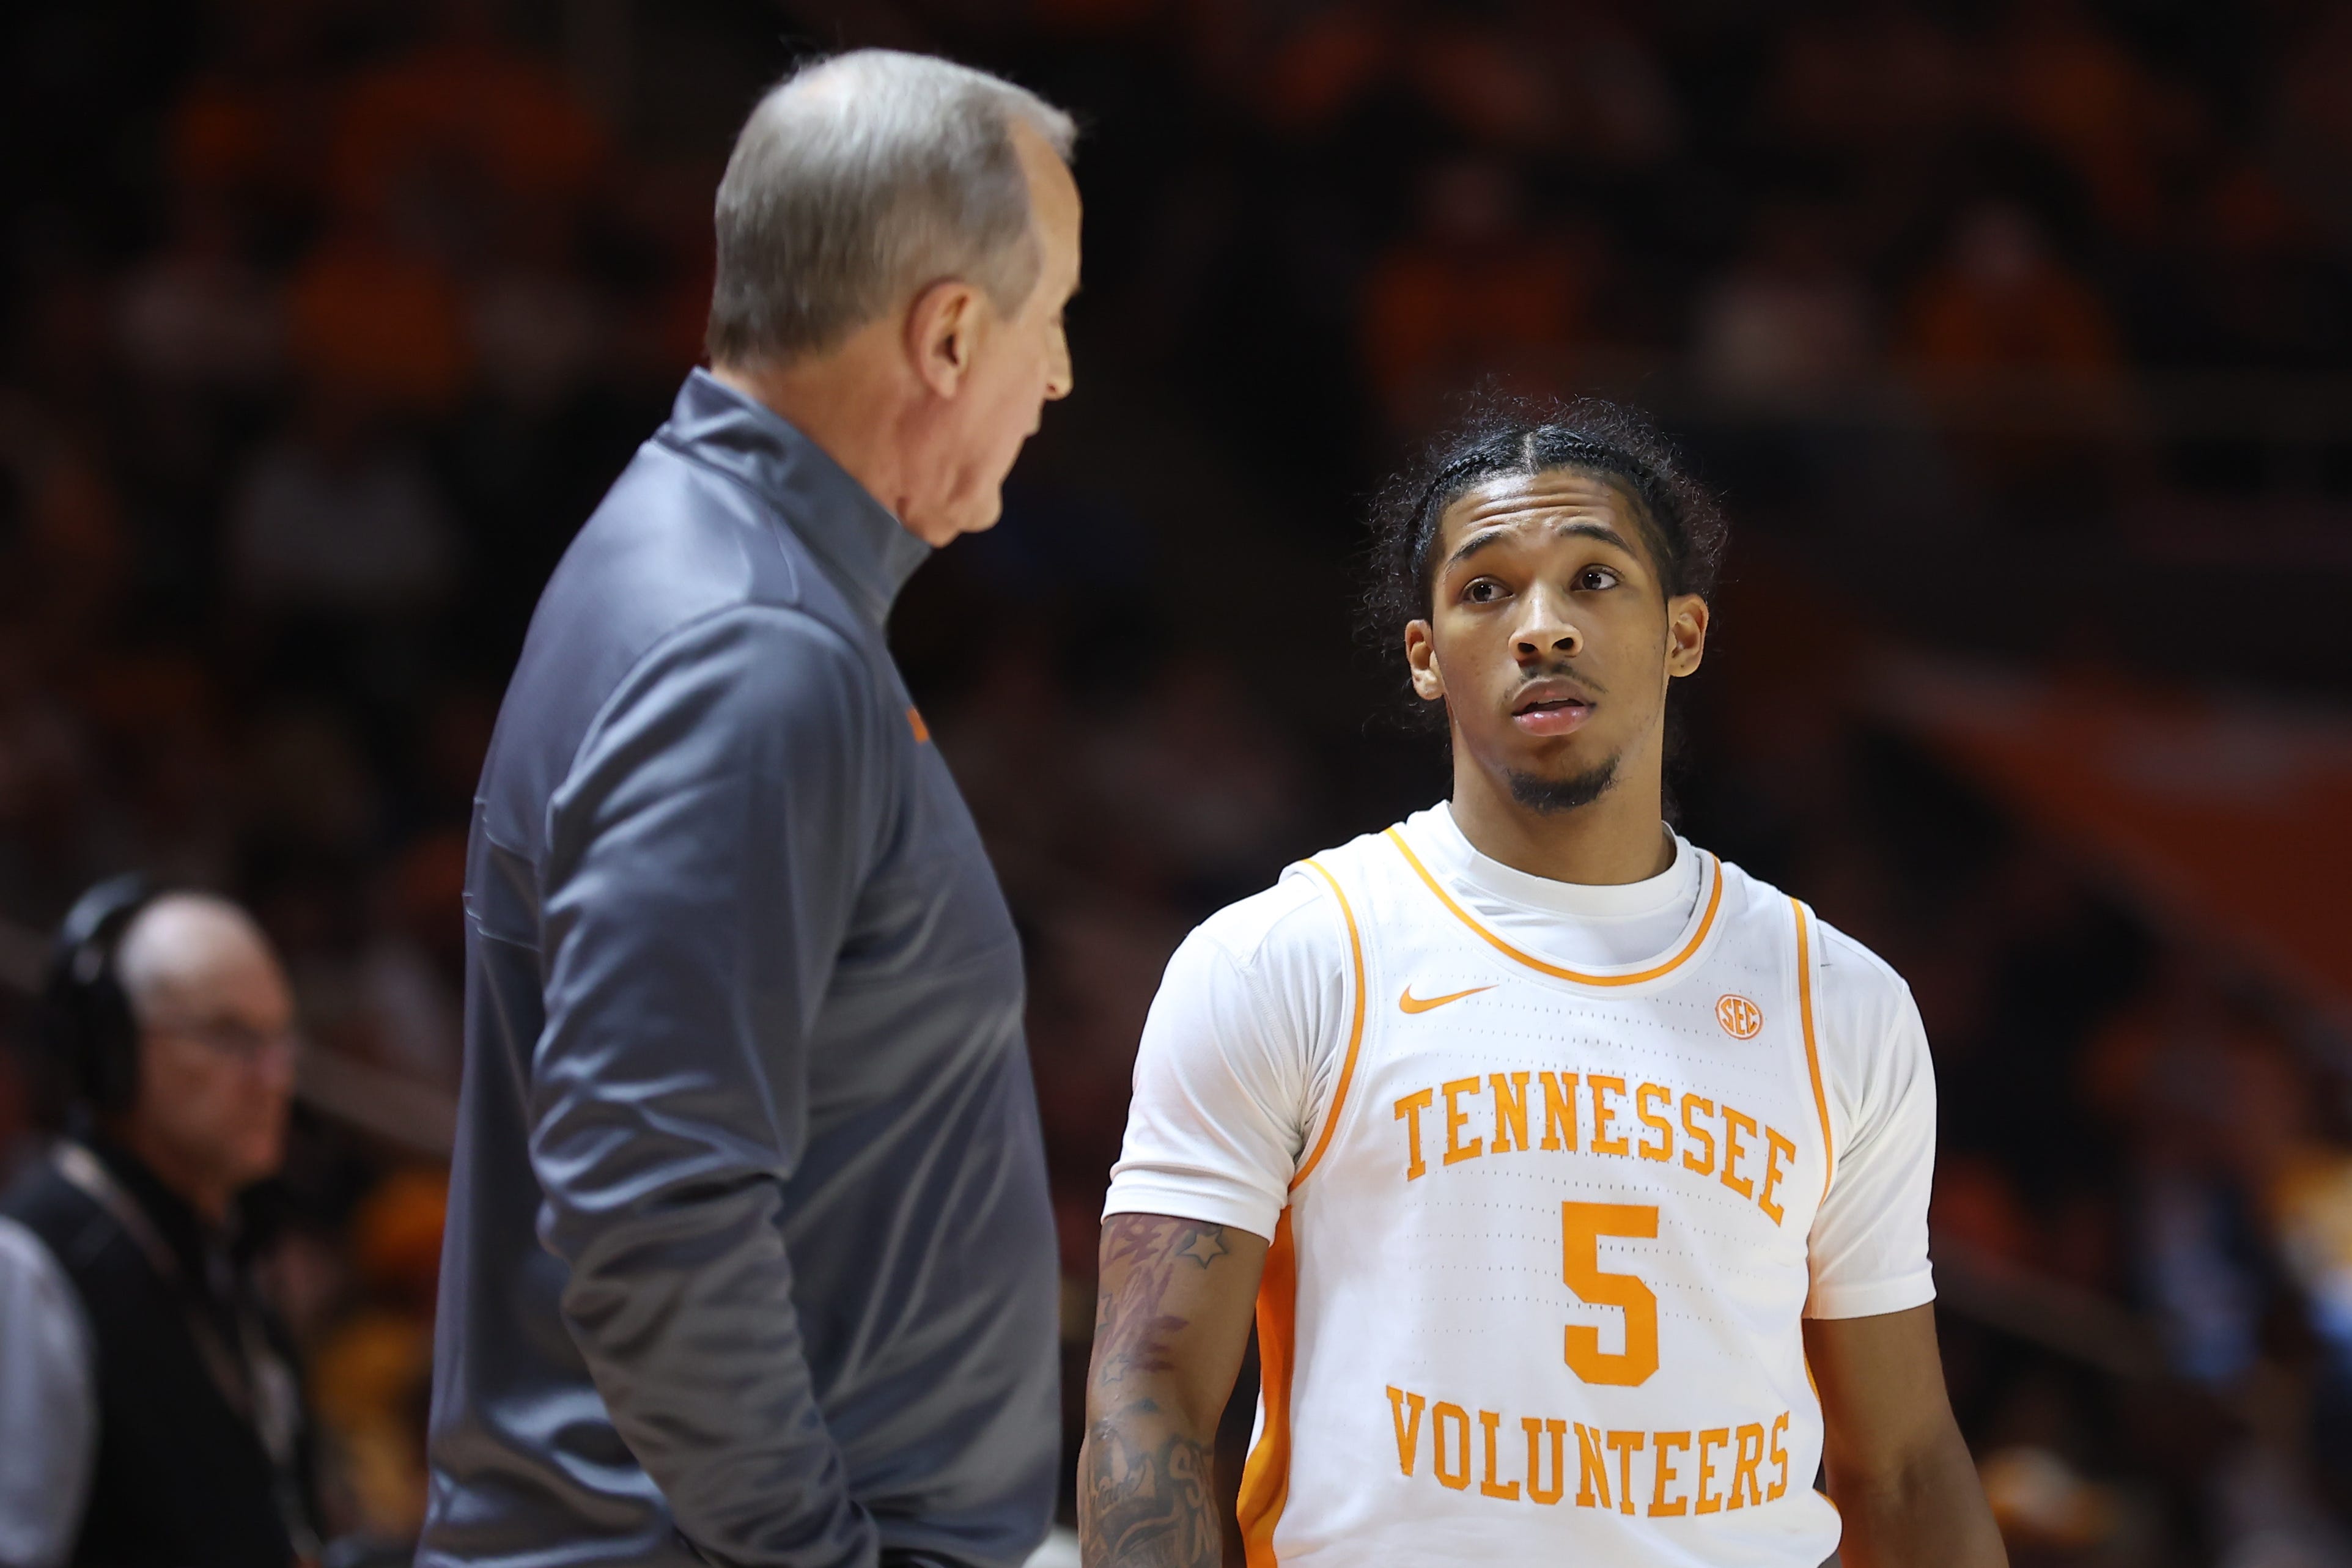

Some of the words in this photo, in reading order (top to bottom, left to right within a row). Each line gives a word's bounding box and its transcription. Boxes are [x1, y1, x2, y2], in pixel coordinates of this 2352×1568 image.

[1720, 998, 1758, 1035] SEC
[1393, 1071, 1796, 1227] TENNESSEE
[1562, 1201, 1659, 1387] 5
[1385, 1384, 1790, 1517] VOLUNTEERS
